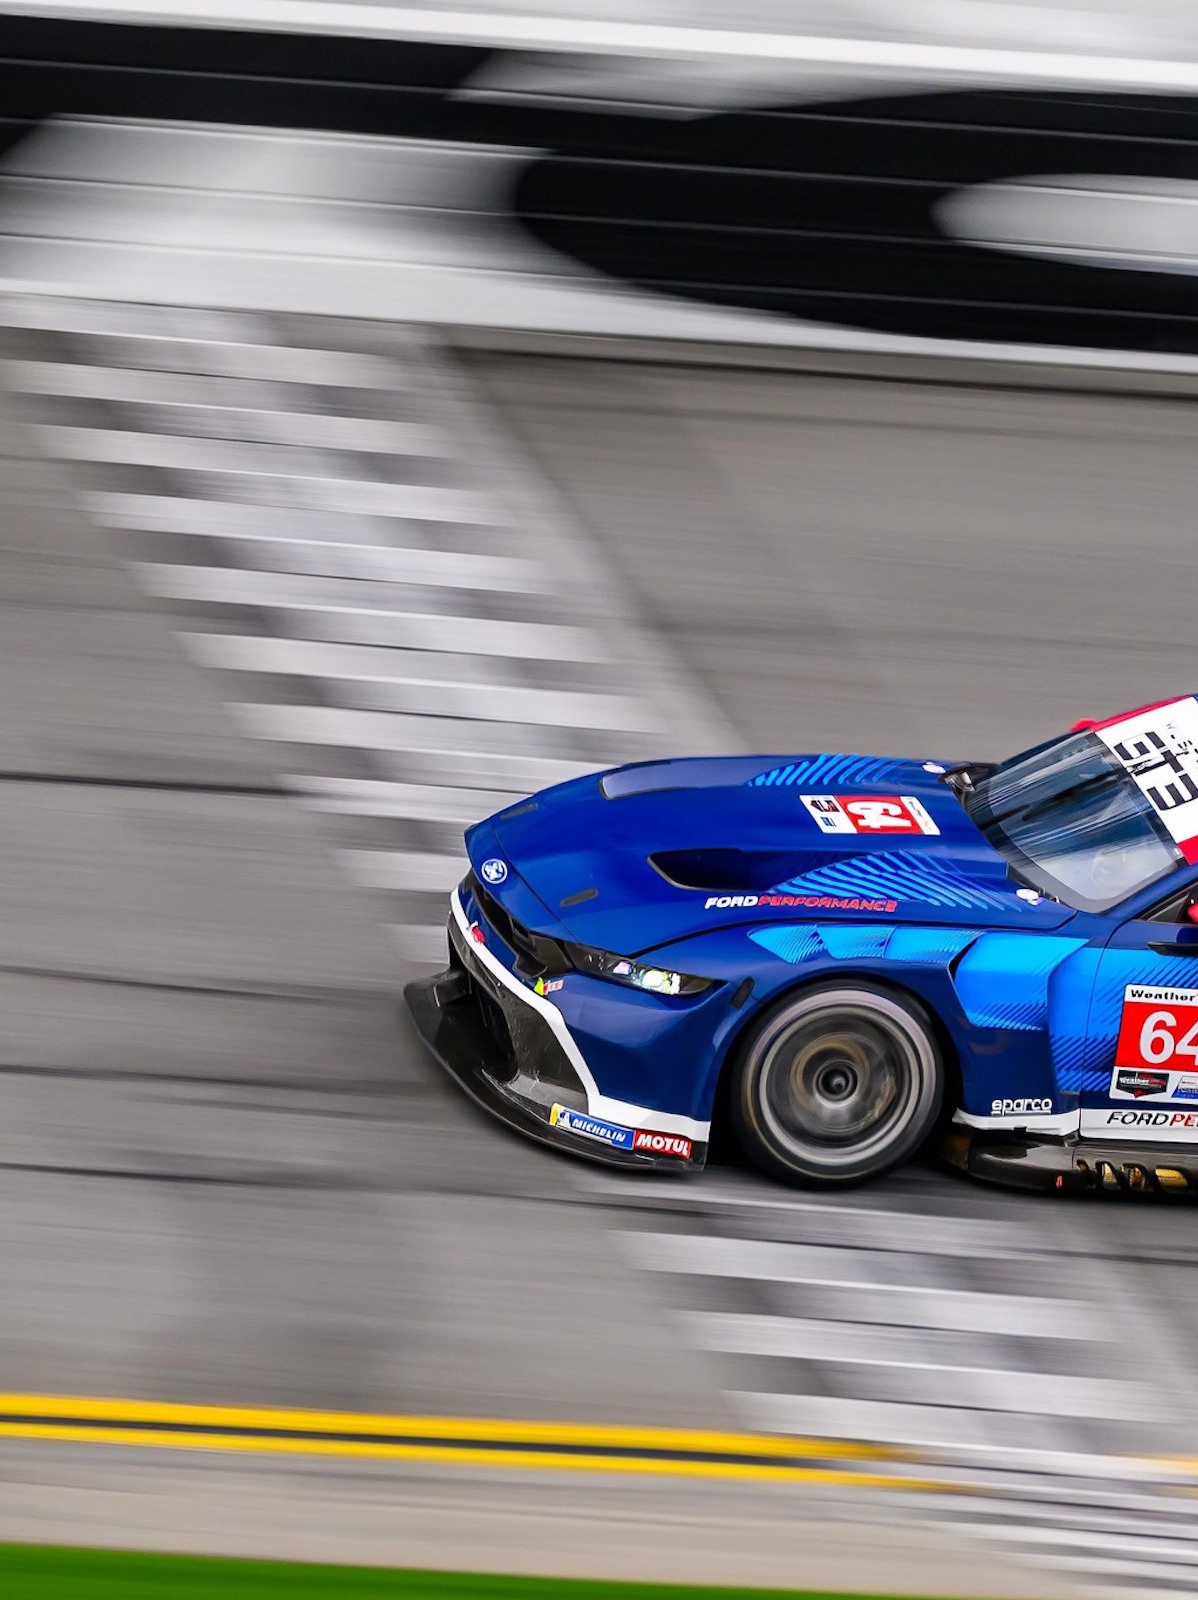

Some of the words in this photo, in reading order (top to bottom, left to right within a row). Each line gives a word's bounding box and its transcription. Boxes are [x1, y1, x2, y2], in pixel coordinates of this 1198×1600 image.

[990, 1098, 1053, 1116] sparco
[571, 1118, 627, 1143] MICHELIN
[636, 1133, 690, 1157] MOTUL
